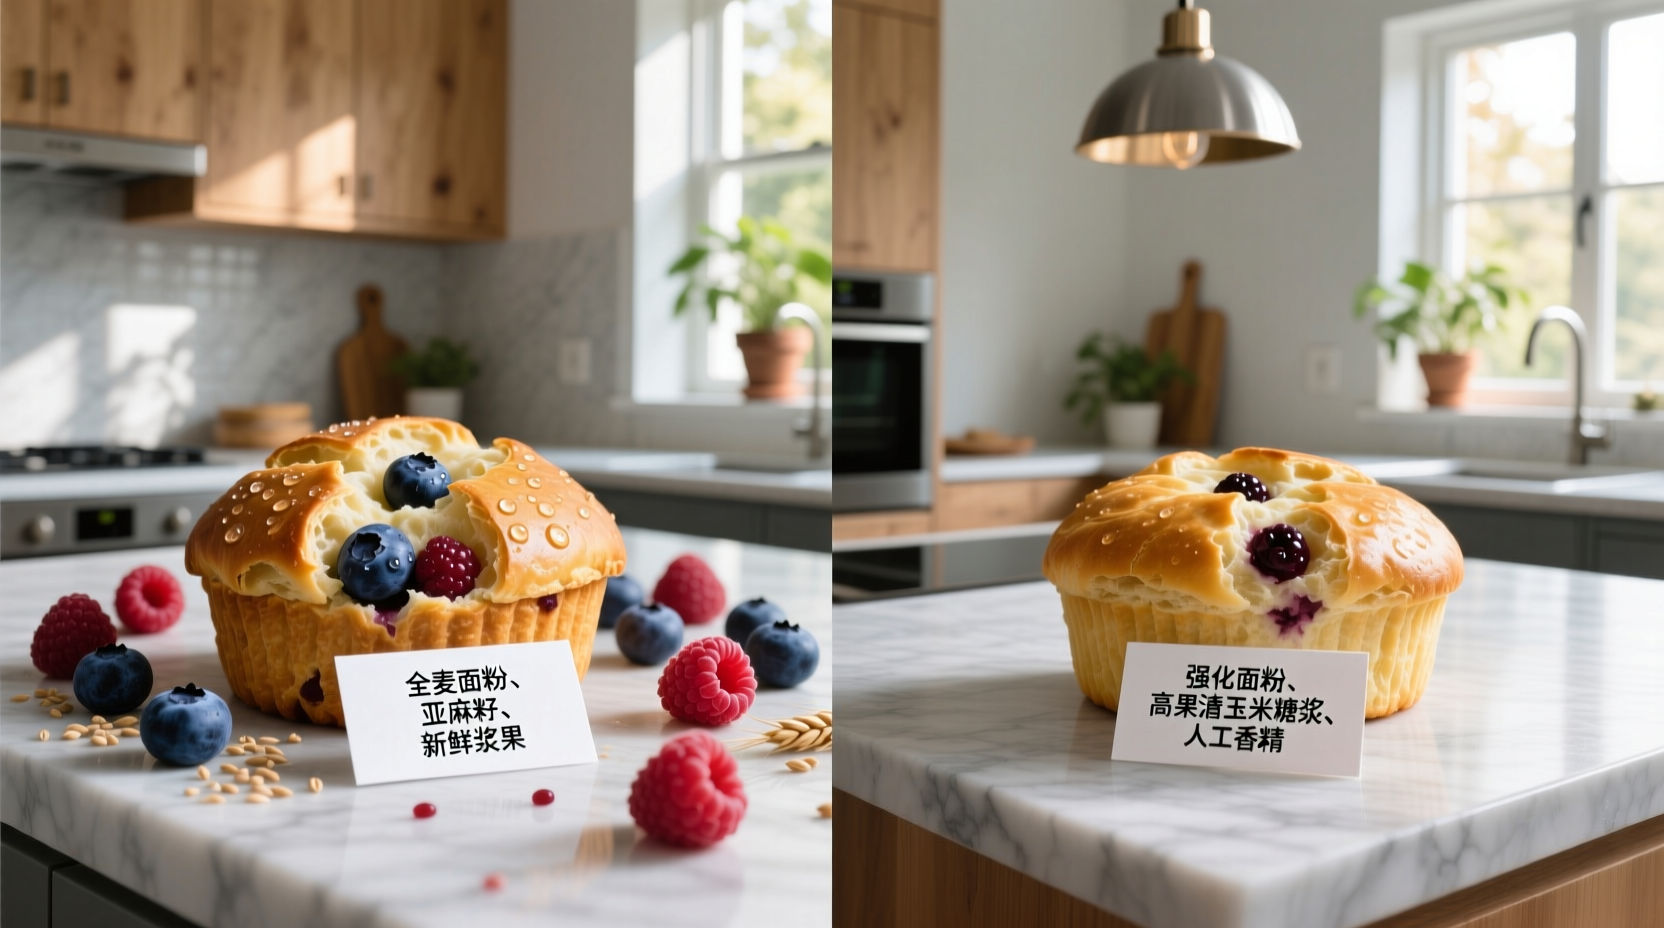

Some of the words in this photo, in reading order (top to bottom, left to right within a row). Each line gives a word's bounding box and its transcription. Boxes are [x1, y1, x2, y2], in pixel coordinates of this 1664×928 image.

[405, 665, 520, 697] 全麦面粉、
[1185, 664, 1296, 693] 强化面粉、
[420, 698, 511, 726] 亚麻籽、
[420, 725, 526, 757] 新鲜浆果
[1183, 723, 1285, 753] 人工香精
